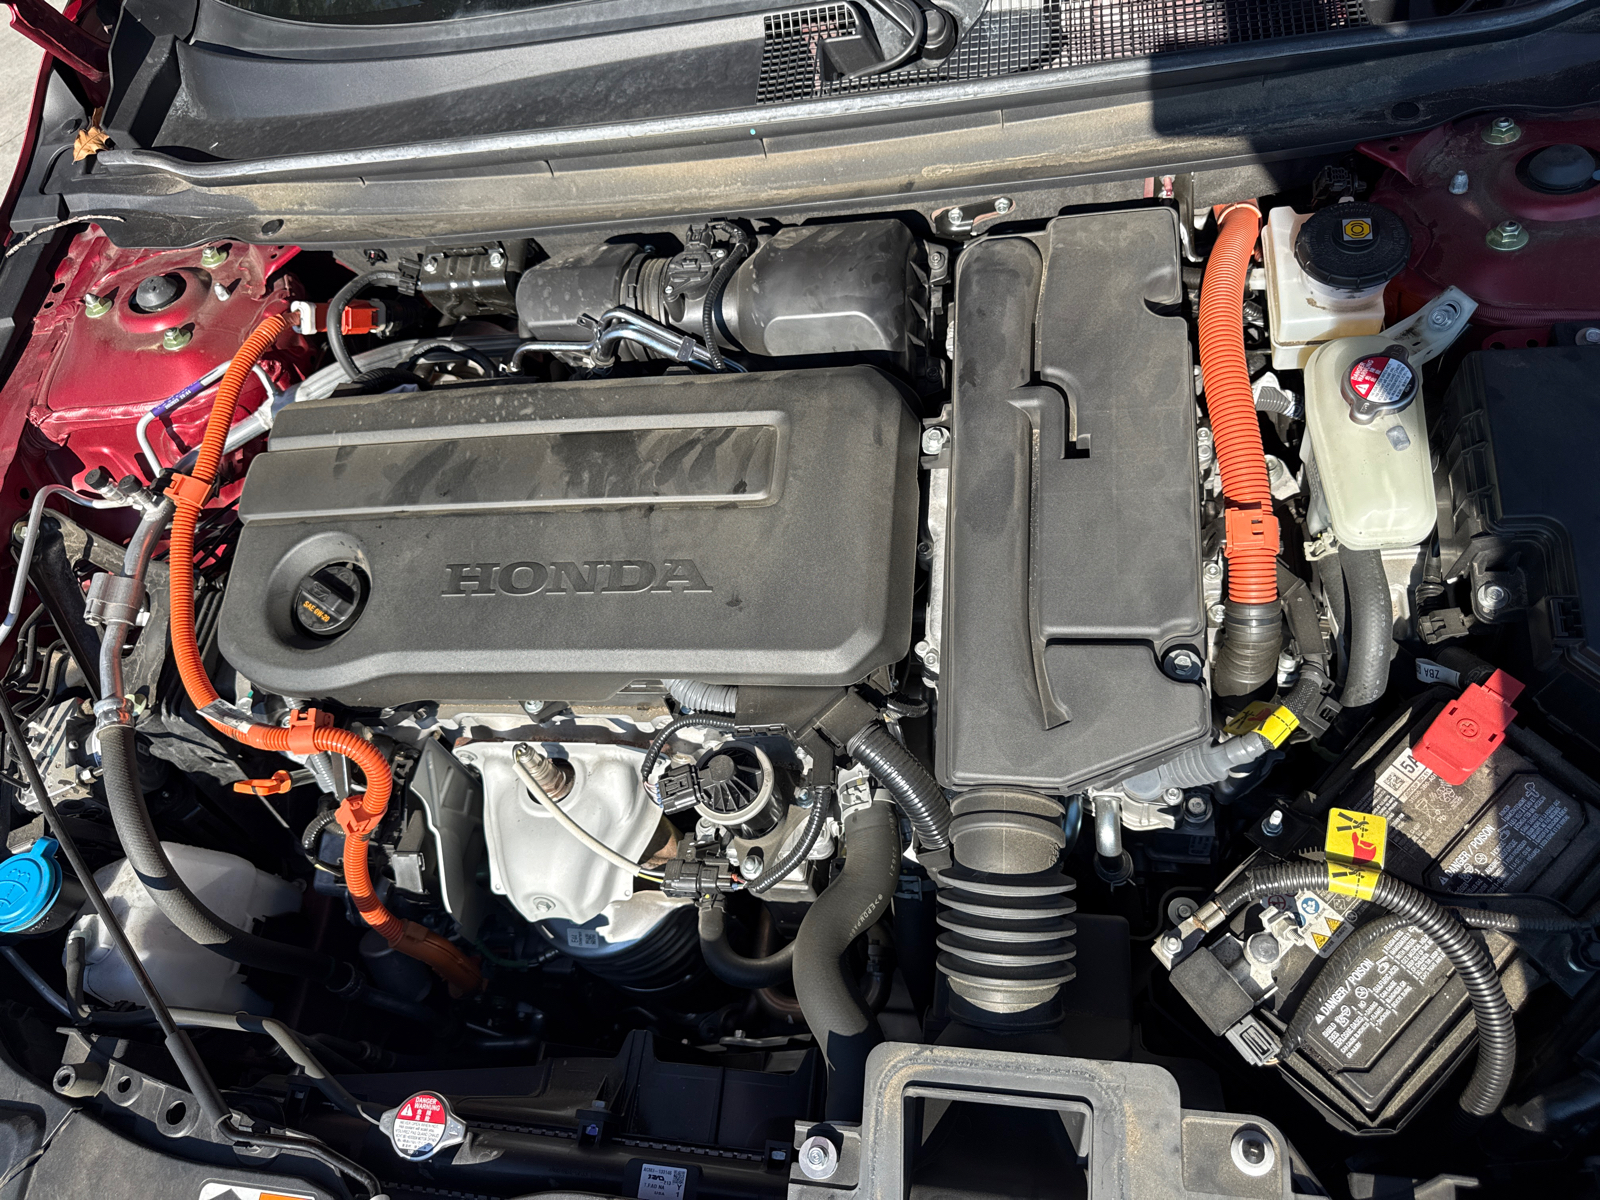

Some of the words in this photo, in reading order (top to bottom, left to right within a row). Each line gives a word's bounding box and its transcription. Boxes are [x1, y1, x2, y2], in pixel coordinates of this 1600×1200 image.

[1351, 361, 1366, 382] DANGER
[1356, 358, 1374, 384] WARNING
[441, 558, 713, 597] HONDA
[303, 600, 316, 612] SAE
[313, 608, 330, 622] 0W-20
[1423, 665, 1440, 680] ZBA
[1436, 813, 1447, 824] Pb
[1443, 849, 1472, 879] DANGER
[1469, 822, 1496, 850] POISON
[1387, 964, 1400, 977] ACID
[1319, 985, 1349, 1016] DANGER
[1347, 957, 1375, 986] POISON
[1357, 999, 1367, 1009] NO
[1321, 1021, 1337, 1038] SHIELD
[1327, 1030, 1340, 1043] EYES
[414, 1103, 441, 1112] WARNING
[415, 1096, 438, 1105] DANGER
